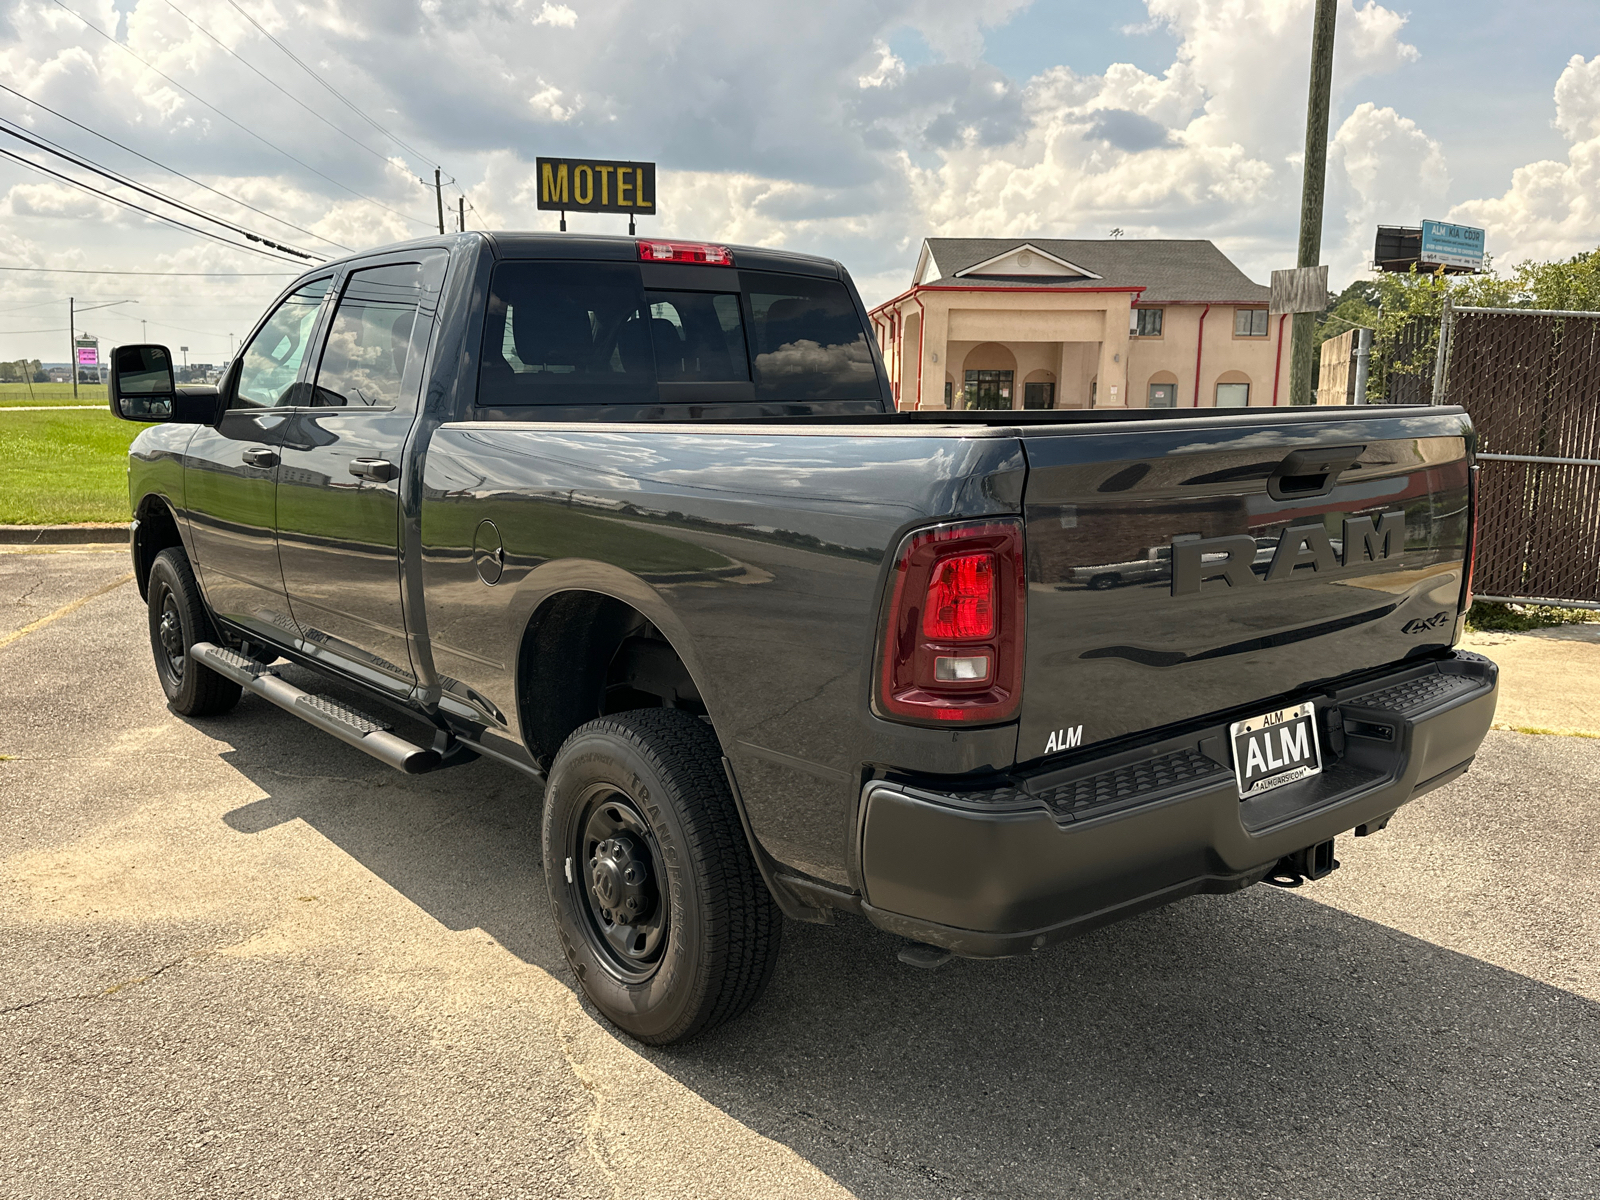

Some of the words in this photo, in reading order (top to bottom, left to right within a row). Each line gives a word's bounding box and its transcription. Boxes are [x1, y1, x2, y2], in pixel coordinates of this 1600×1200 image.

[542, 163, 653, 207] MOTEL
[1432, 225, 1445, 236] ALM
[1449, 228, 1460, 238] KIA
[1464, 230, 1480, 241] CDJR
[1171, 510, 1406, 597] RAM
[1263, 710, 1284, 728] ALM
[1044, 724, 1083, 754] ALM
[1245, 721, 1310, 778] ALM
[1260, 770, 1305, 790] ALMCARS.COM
